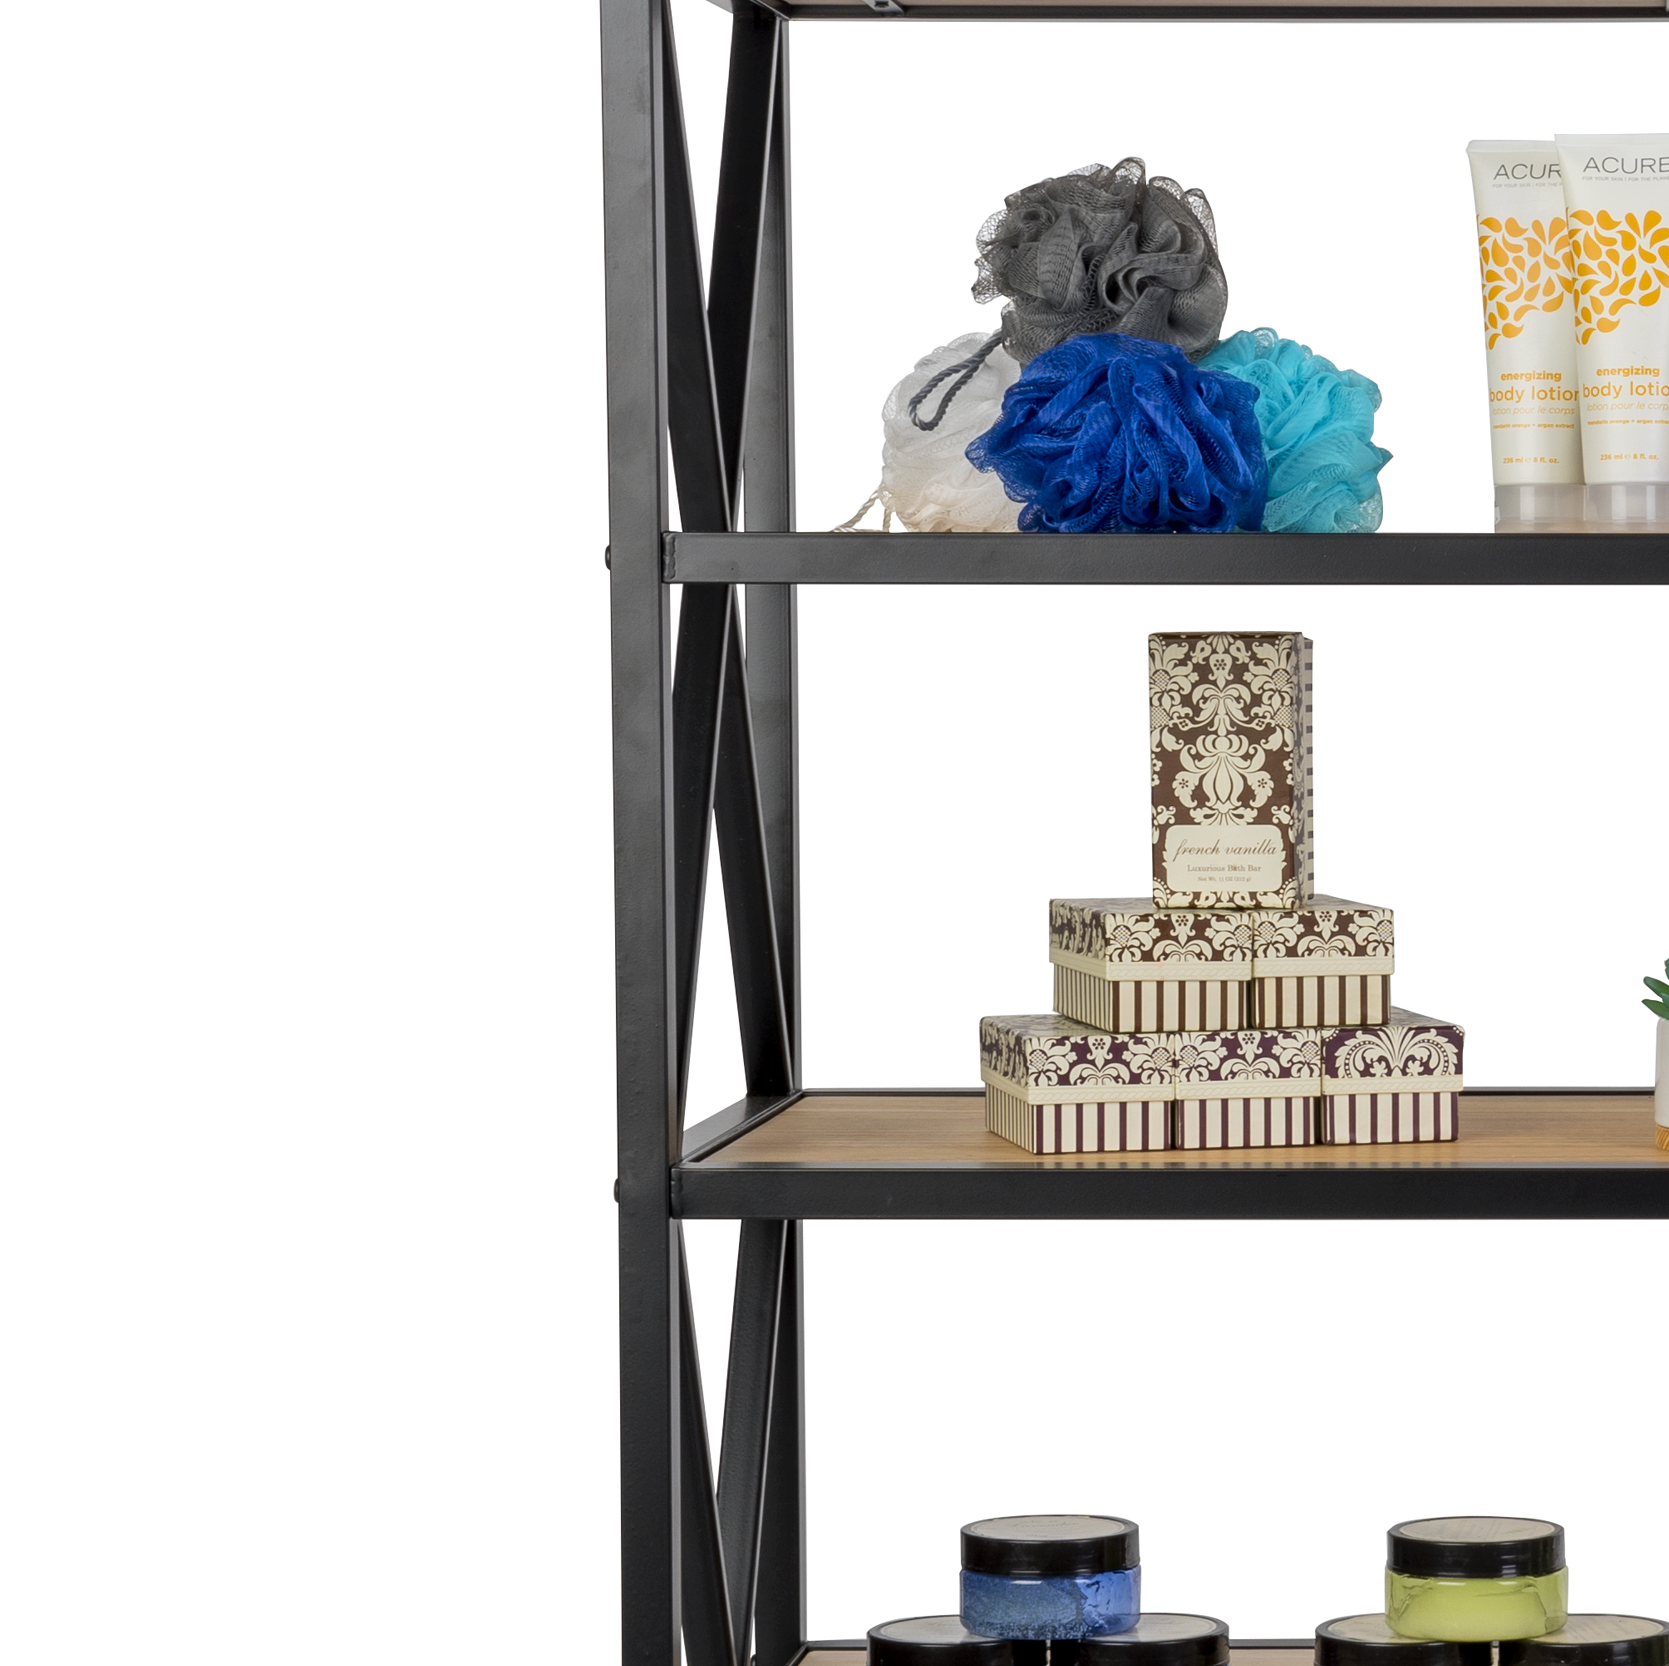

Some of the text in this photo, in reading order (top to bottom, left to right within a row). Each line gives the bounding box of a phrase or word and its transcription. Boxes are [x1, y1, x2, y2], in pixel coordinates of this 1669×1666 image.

[1493, 163, 1561, 180] ACUR
[1500, 370, 1562, 382] energizing
[1596, 365, 1660, 377] energizing
[1489, 386, 1525, 403] body
[1583, 382, 1623, 399] body
[1513, 408, 1536, 416] pour
[1548, 407, 1575, 416] corps
[1587, 403, 1608, 411] lotion
[1610, 403, 1634, 411] pour
[1636, 401, 1645, 410] le
[1172, 838, 1277, 863] french vanilla
[1187, 864, 1262, 872] Luxurious Bath Bar
